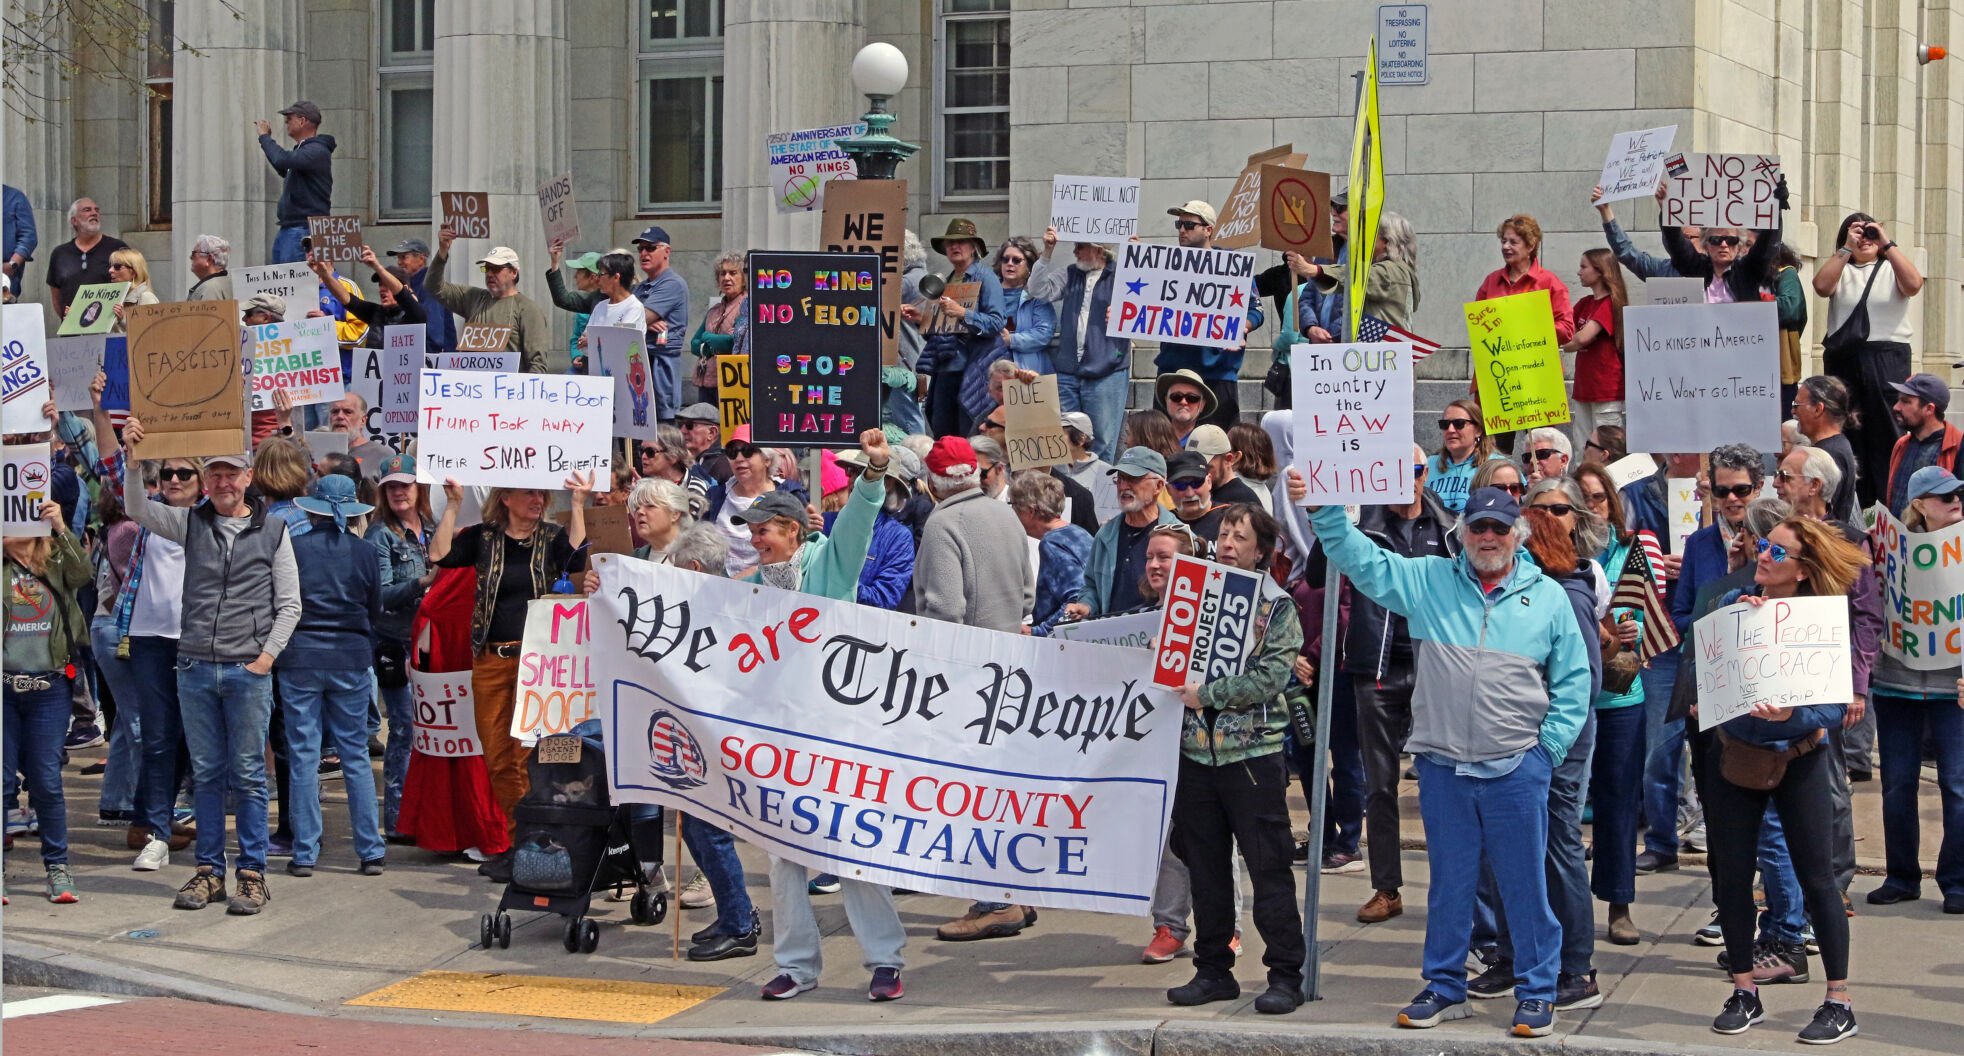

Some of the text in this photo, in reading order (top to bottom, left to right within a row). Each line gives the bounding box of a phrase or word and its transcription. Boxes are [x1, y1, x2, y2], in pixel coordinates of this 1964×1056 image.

[1381, 60, 1423, 68] SKATEBOARDING
[791, 126, 852, 141] ANNIVERSARY
[854, 125, 866, 136] OF
[1629, 132, 1654, 150] WE
[770, 144, 787, 154] THE
[789, 142, 816, 152] START
[820, 140, 831, 150] OF
[771, 152, 814, 165] AMERICAN
[789, 161, 850, 175] NO KINGS
[1706, 154, 1745, 178] NO
[1620, 164, 1639, 178] WE
[538, 178, 570, 208] HANDS
[1054, 184, 1140, 204] HATE WILL NOT
[1674, 177, 1772, 203] TURD
[452, 195, 478, 214] NO
[548, 201, 564, 222] OFF
[1234, 203, 1254, 218] NO
[310, 218, 361, 235] IMPEACH
[444, 216, 490, 238] KINGS
[843, 213, 884, 241] WE
[1052, 216, 1137, 236] MAKE US GREAT
[1215, 216, 1257, 240] KINGS
[324, 234, 346, 246] THE
[313, 248, 363, 262] FELON
[1124, 244, 1254, 278] NATIONALISM
[758, 268, 792, 289] NO
[814, 271, 873, 291] KING
[96, 288, 120, 301] Kings
[1160, 280, 1232, 310] IS NOT
[759, 304, 794, 324] NO
[801, 296, 877, 327] FELON
[1118, 301, 1240, 341] PATRIOTISM
[1468, 306, 1496, 326] Sure,
[392, 334, 415, 348] HATE
[459, 327, 512, 349] RESIST
[1481, 336, 1547, 357] Well-informed
[1666, 336, 1696, 350] KINGS
[1700, 338, 1711, 348] IN
[1714, 326, 1764, 349] AMERICA
[148, 350, 230, 378] FASCIST
[400, 354, 409, 366] IS
[450, 356, 504, 370] MORONS
[776, 354, 855, 376] STOP
[1310, 348, 1397, 372] In OUR
[1490, 360, 1545, 379] Open-minded
[394, 373, 412, 385] NOT
[1314, 375, 1386, 400] country
[1495, 378, 1522, 396] Kind
[1669, 376, 1706, 399] WON'T
[1711, 386, 1728, 398] GO
[396, 392, 410, 404] AN
[530, 377, 559, 403] The
[566, 380, 610, 408] Poor
[788, 384, 842, 406] THE
[1008, 382, 1044, 406] DUE
[1336, 399, 1362, 411] the
[1500, 396, 1547, 412] Empathetic
[778, 412, 855, 434] HATE
[1314, 414, 1390, 434] LAW
[1486, 402, 1567, 430] Why aren't you?
[1008, 435, 1068, 464] PROCESS
[1342, 439, 1360, 452] is
[1160, 576, 1199, 673] STOP
[1191, 588, 1219, 673] PROJECT
[1730, 609, 1765, 648] THE
[1775, 601, 1842, 645] PEOPLE
[1211, 593, 1249, 679] 2025
[617, 586, 1155, 754] We are The People
[444, 684, 468, 698] is
[1740, 682, 1758, 694] NOT
[547, 753, 574, 761] DOGE
[720, 736, 1094, 830] SOUTH COUNTY
[722, 773, 1088, 876] RESISTANCE
